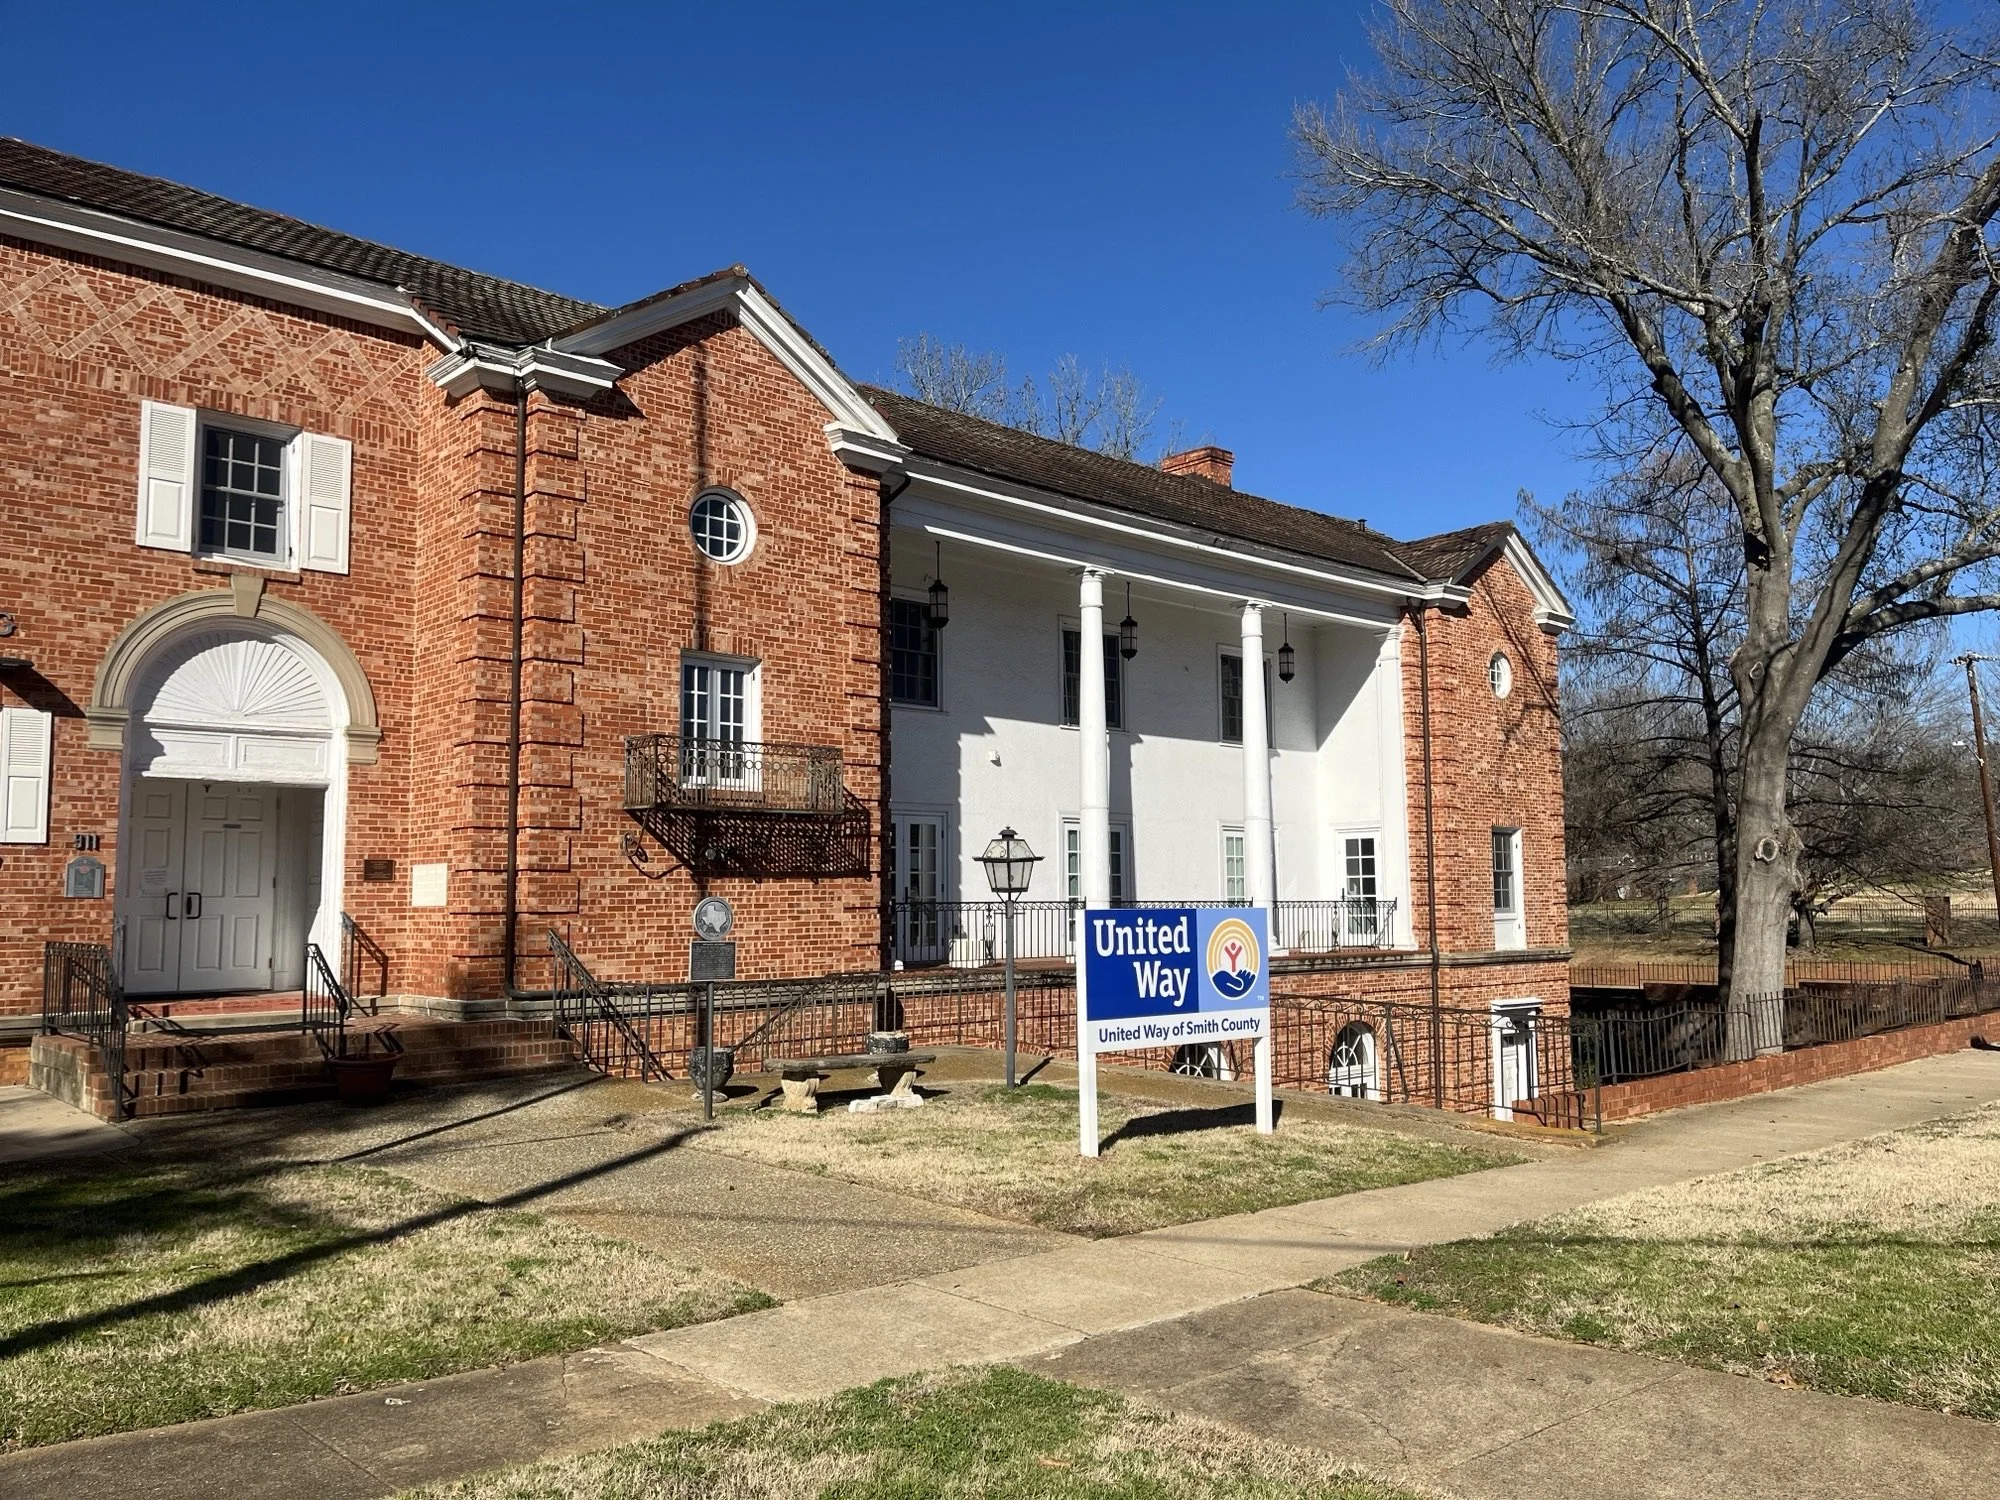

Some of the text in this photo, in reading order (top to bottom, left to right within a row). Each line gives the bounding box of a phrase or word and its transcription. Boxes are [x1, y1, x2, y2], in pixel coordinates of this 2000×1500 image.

[73, 832, 97, 849] 911
[1093, 916, 1191, 957] United
[1133, 960, 1191, 1007] Way
[1099, 1017, 1260, 1043] United Way of Smith County
